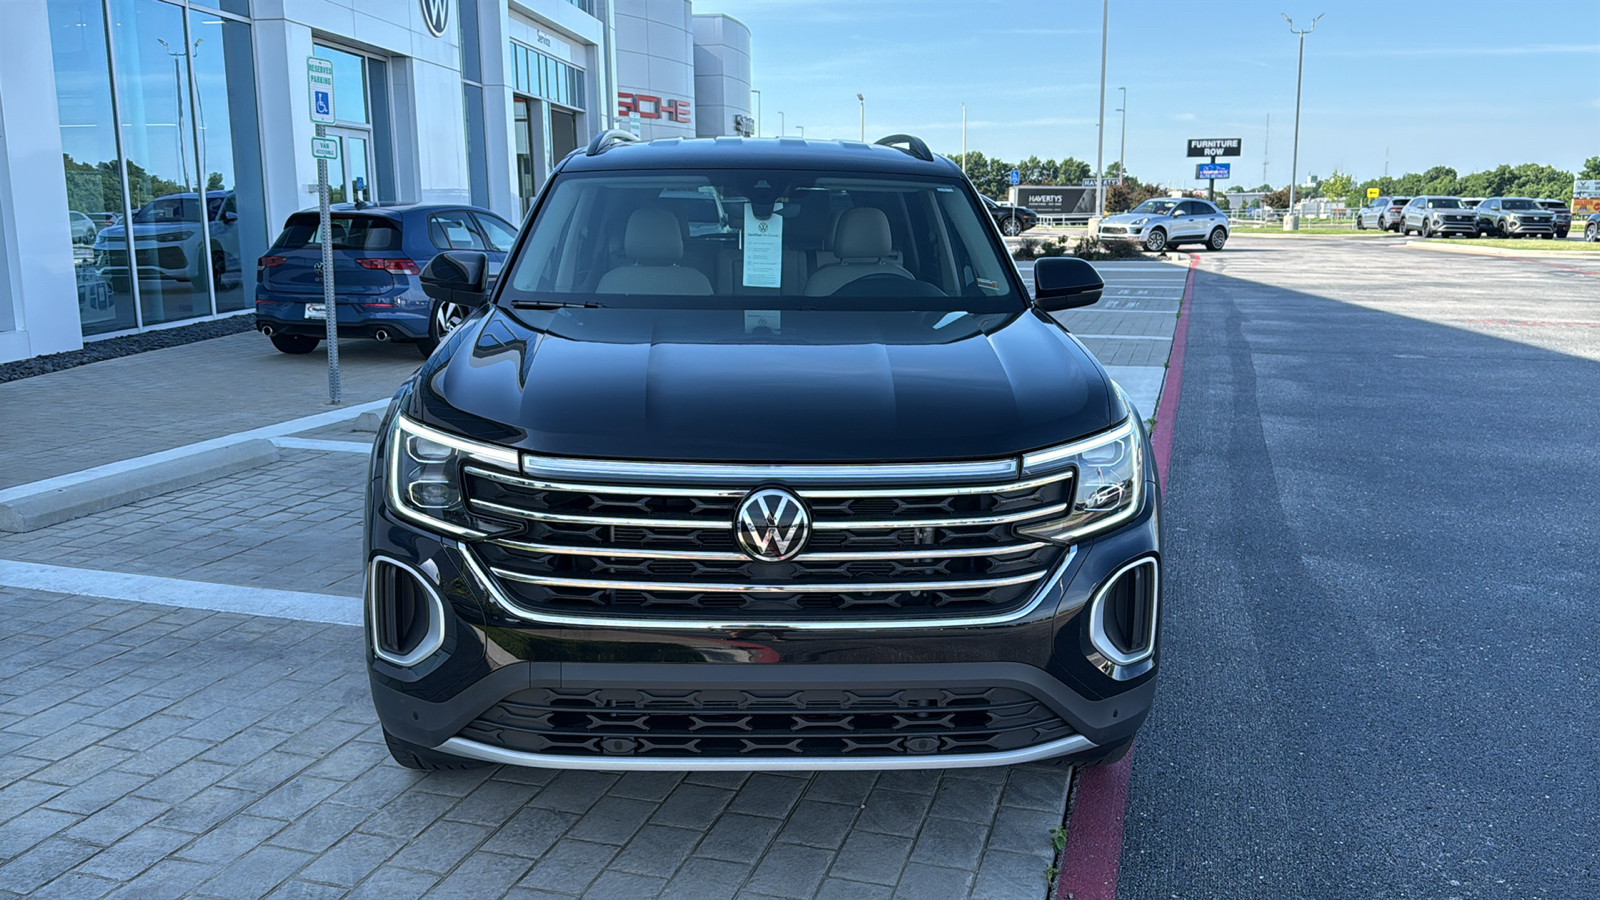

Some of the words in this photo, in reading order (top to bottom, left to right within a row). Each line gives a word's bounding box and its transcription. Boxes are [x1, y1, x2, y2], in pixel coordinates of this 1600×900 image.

[537, 29, 551, 47] Service
[308, 64, 333, 74] RESERVED
[310, 75, 331, 85] PARKING
[1191, 139, 1239, 148] FURNITURE
[1203, 147, 1225, 156] ROW
[1028, 194, 1063, 203] HAVERTYS
